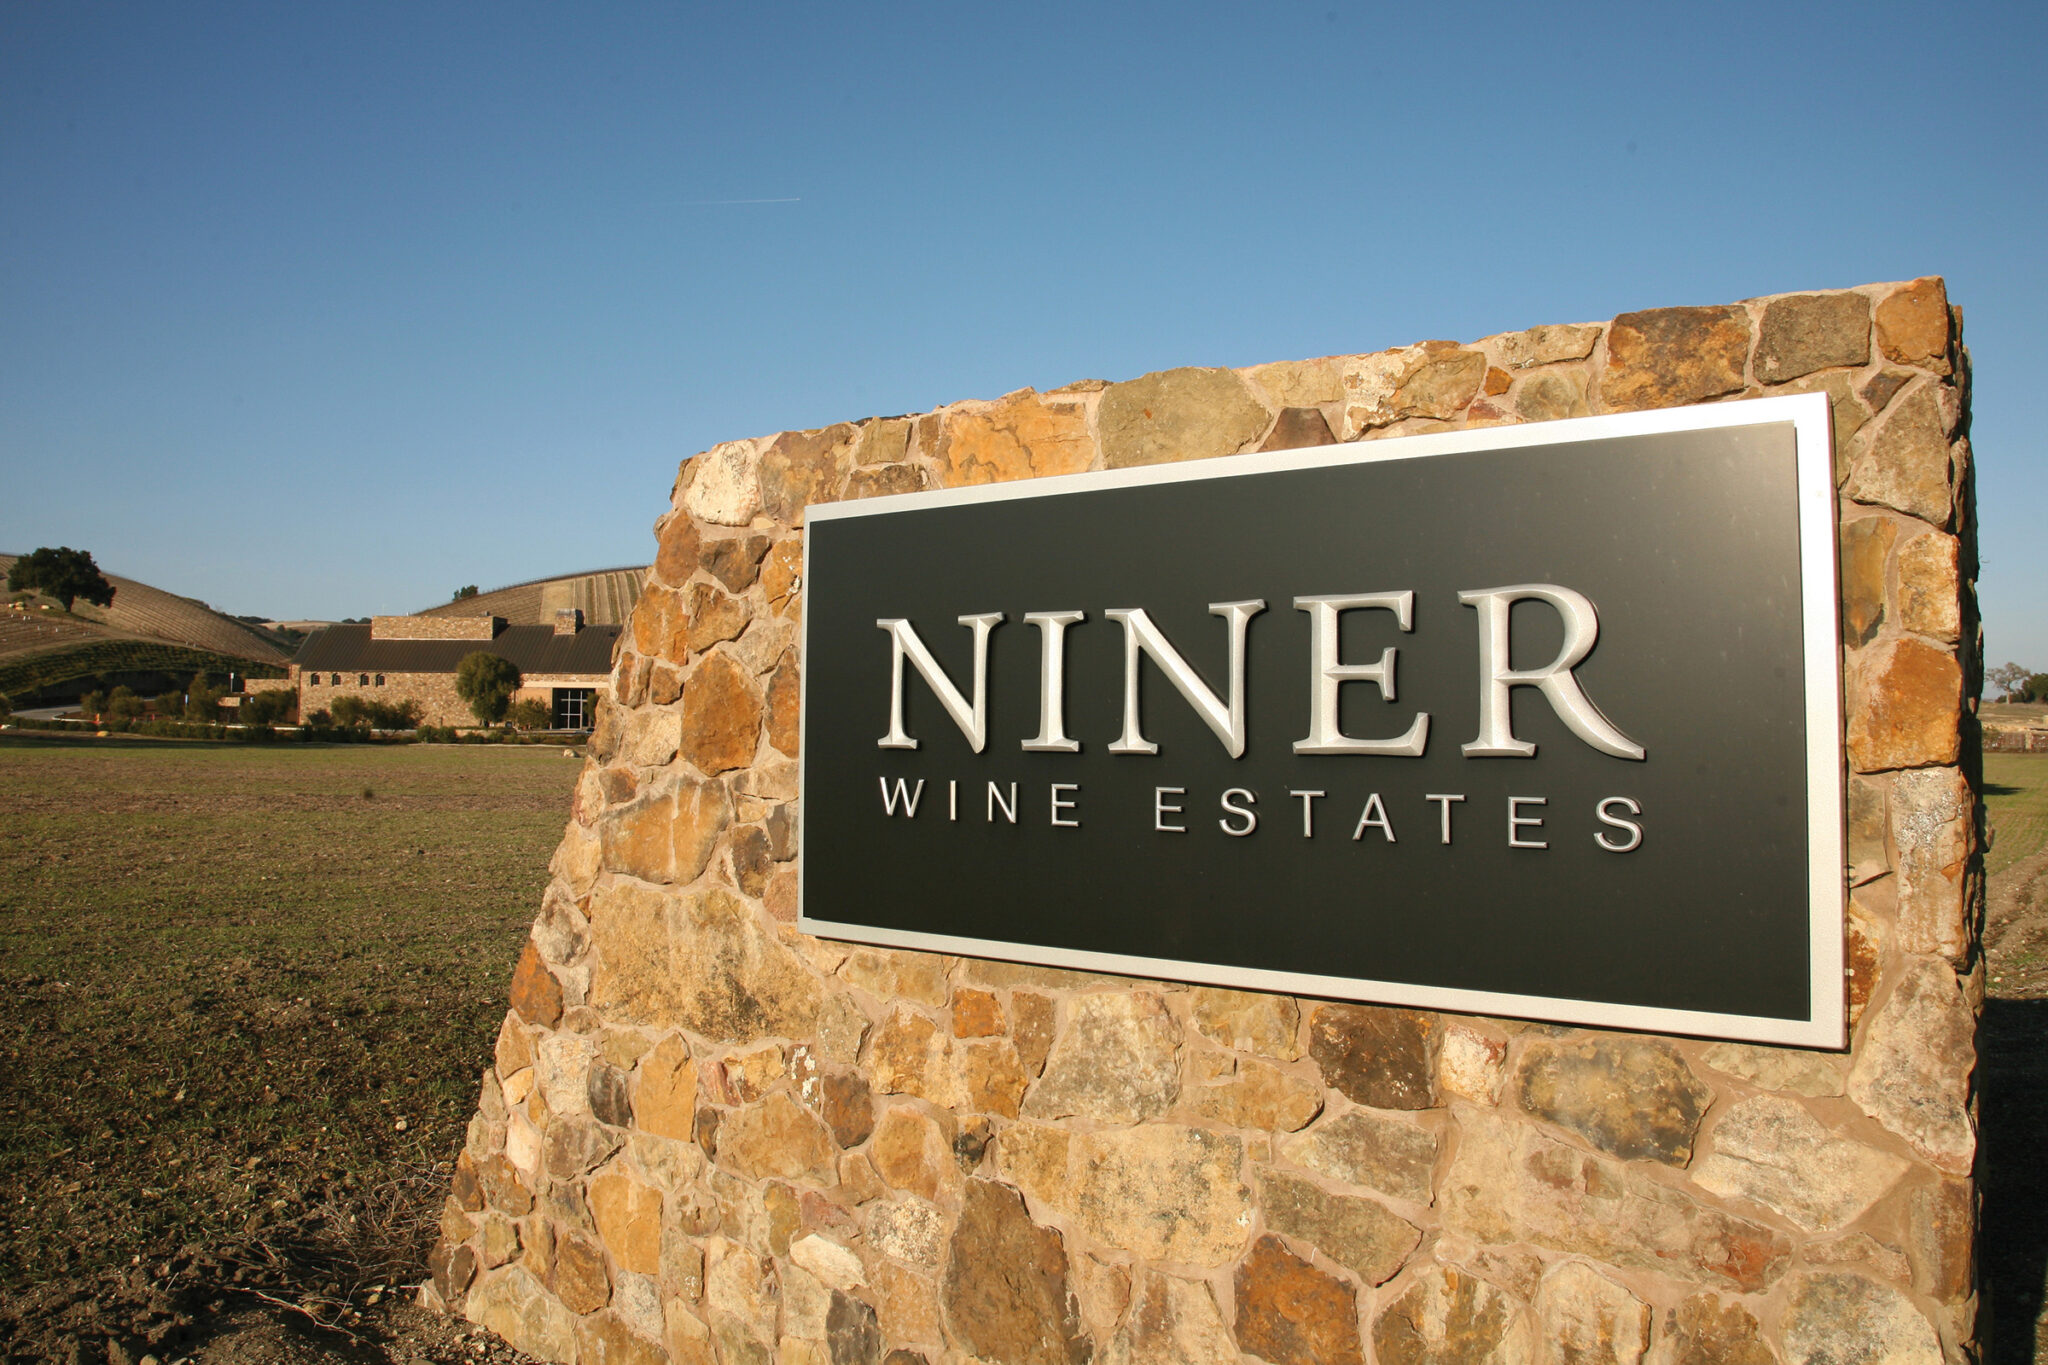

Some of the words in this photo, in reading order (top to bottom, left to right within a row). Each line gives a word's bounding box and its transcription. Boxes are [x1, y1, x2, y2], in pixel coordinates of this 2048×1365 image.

[875, 583, 1646, 761] NINER
[878, 776, 1082, 828] WINE
[1154, 786, 1644, 853] ESTATES
